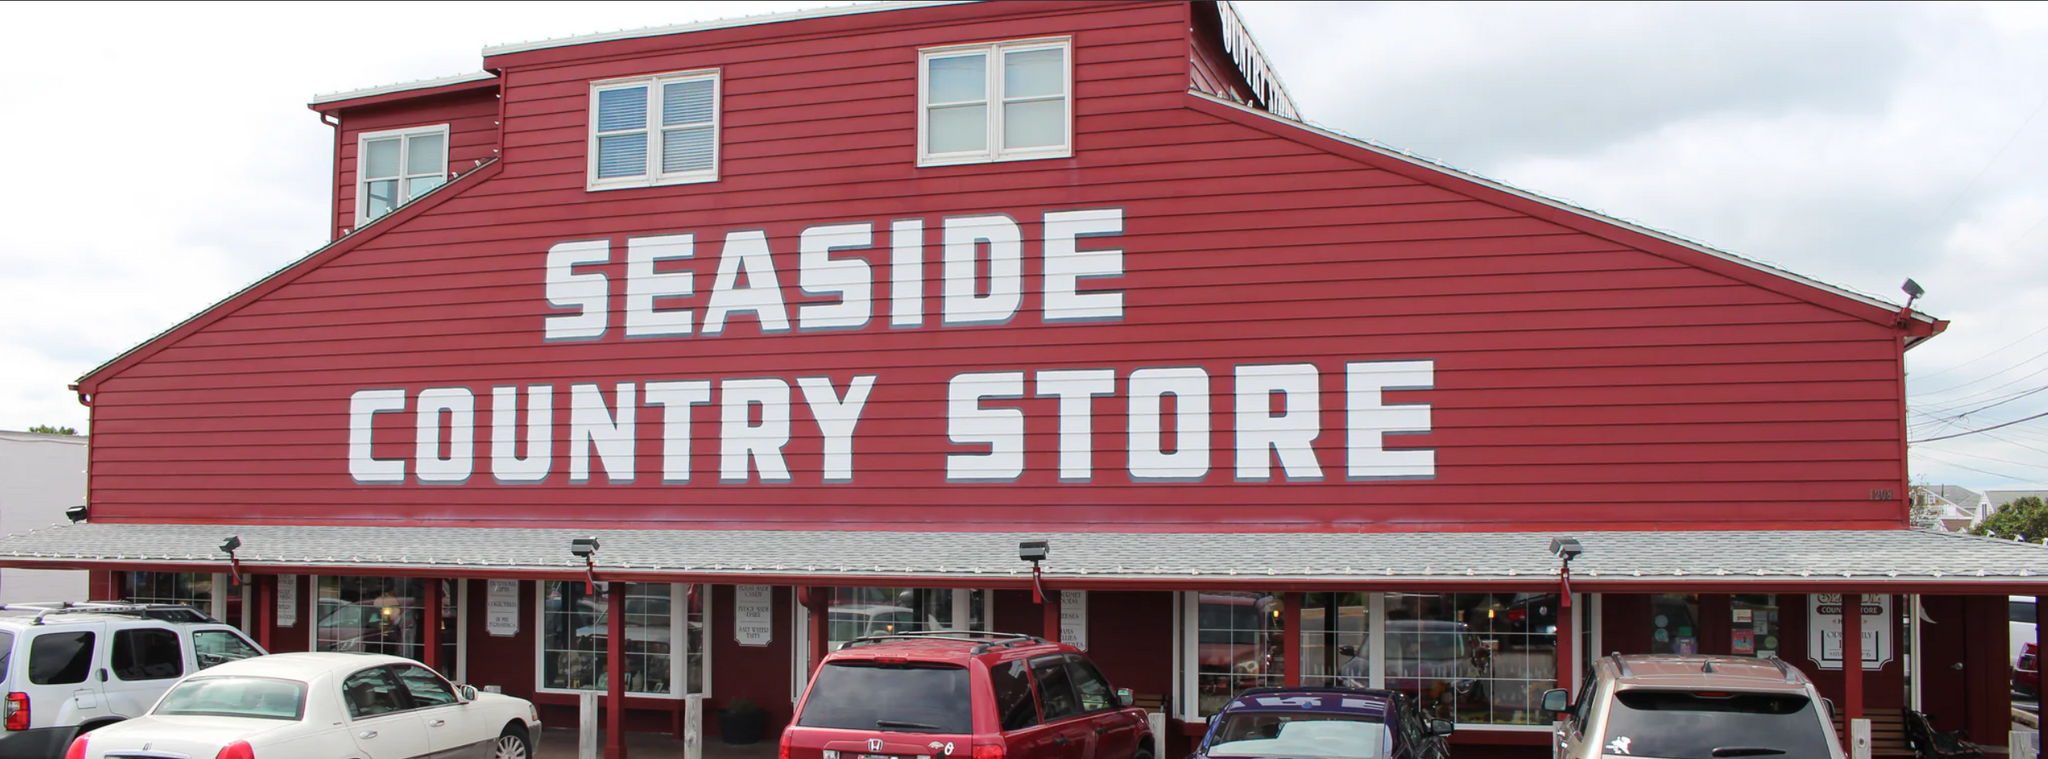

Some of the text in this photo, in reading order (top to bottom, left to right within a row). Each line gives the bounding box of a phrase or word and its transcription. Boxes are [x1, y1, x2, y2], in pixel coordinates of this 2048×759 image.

[544, 208, 1125, 341] SEASIDE
[348, 359, 1437, 484] COUNTRY STORE
[1870, 489, 1893, 501] 1208
